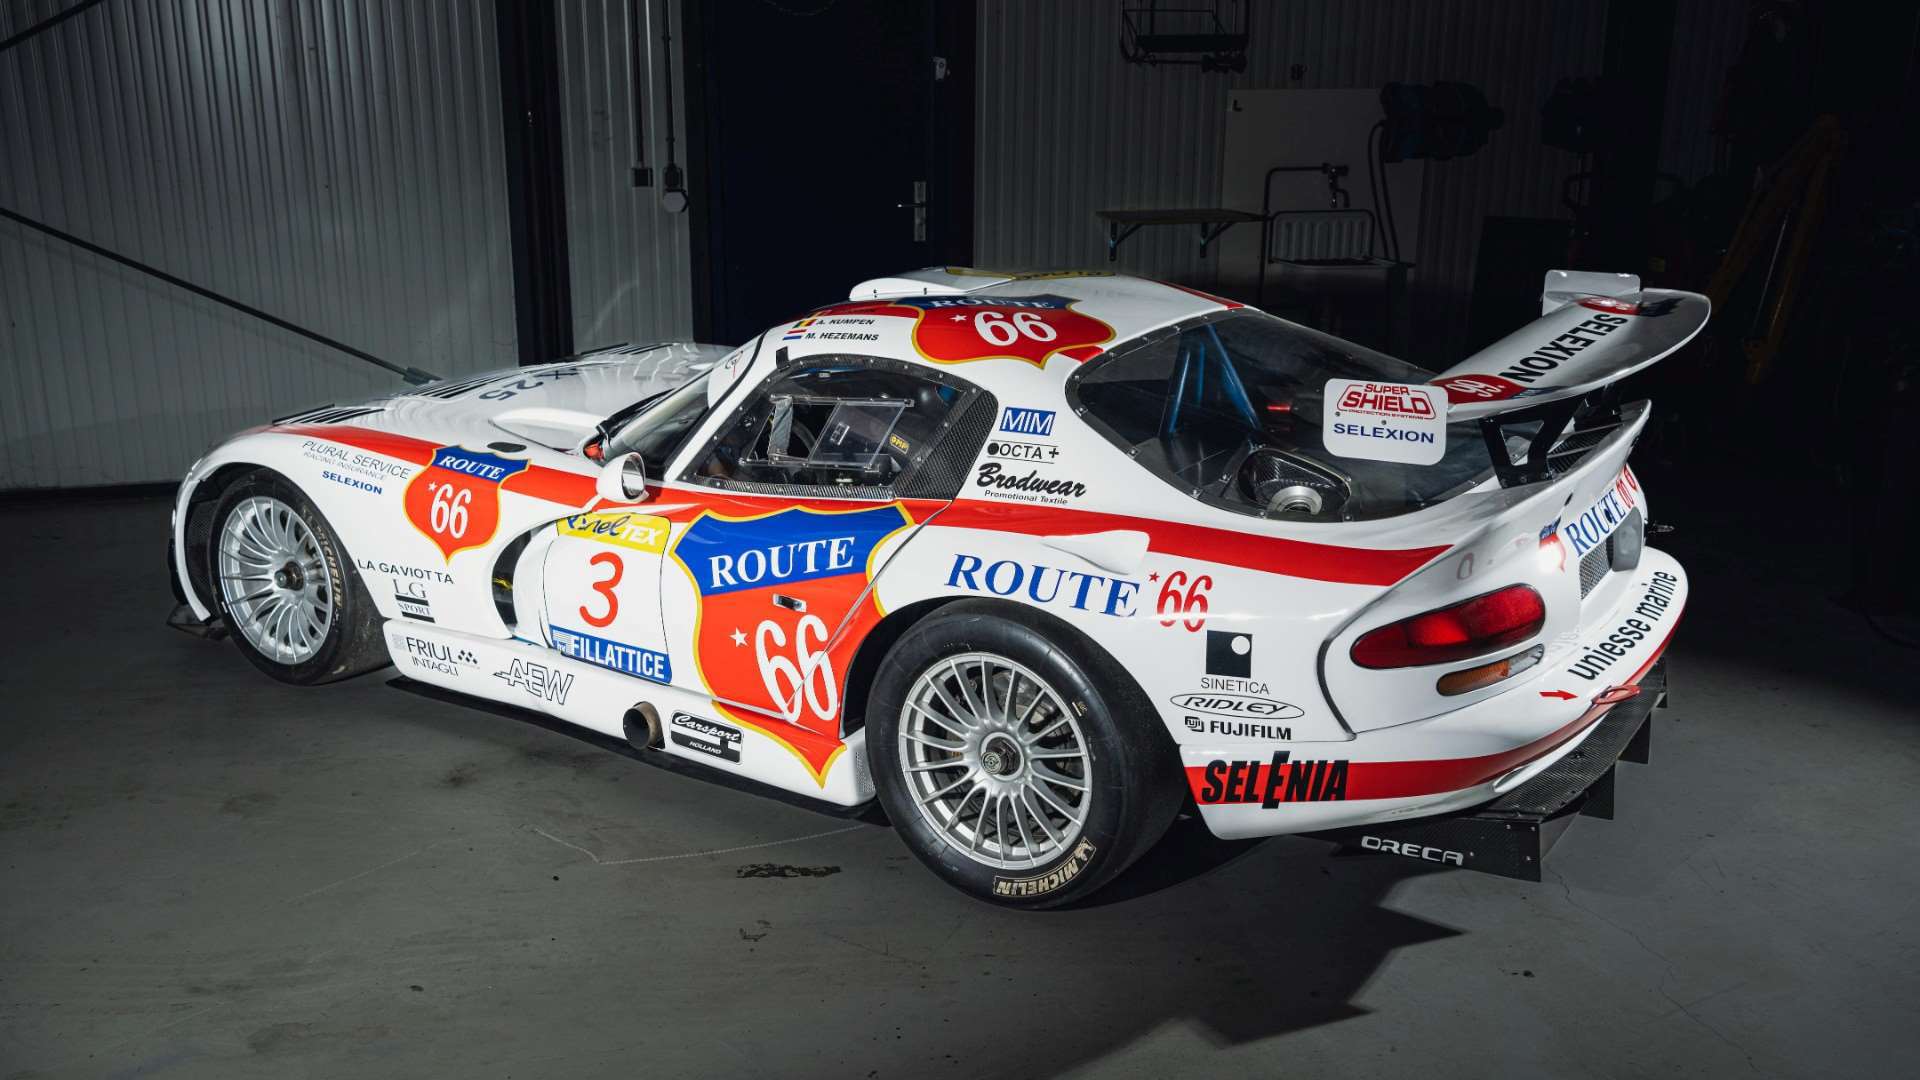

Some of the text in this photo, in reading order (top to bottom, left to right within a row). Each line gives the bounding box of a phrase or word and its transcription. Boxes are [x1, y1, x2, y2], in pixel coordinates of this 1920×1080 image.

[931, 299, 1056, 309] ROUTE
[819, 332, 879, 341] HEZEMANS
[974, 311, 1057, 346] 66
[1498, 313, 1629, 383] SELEXION
[1364, 384, 1410, 395] SUPER
[1342, 391, 1431, 415] SHIELD
[1001, 409, 1054, 435] MIM
[1333, 423, 1434, 444] SELEXION
[302, 440, 411, 480] PLURAL SERVICE
[1000, 443, 1042, 460] OCTA
[439, 454, 505, 480] ROUTE
[976, 462, 1087, 498] Brodwear
[322, 470, 383, 495] SELEXION
[984, 490, 1068, 505] Promotional Textile
[430, 483, 472, 540] 66
[1564, 487, 1627, 557] ROUTE
[357, 559, 454, 585] LA GAVIOTTA
[708, 536, 855, 588] ROUTE
[393, 578, 427, 599] LG
[579, 551, 624, 628] 3
[943, 552, 1214, 633] ROUTE 66
[398, 602, 431, 616] SPORT
[1567, 570, 1679, 682] uniesse marine
[571, 636, 665, 679] FILLATTICE
[754, 614, 839, 723] 66
[494, 658, 574, 705] AEW
[1201, 677, 1270, 695] SINETICA
[1184, 697, 1288, 715] RIDLEY
[674, 715, 740, 741] Carsport
[1210, 721, 1292, 740] FUJIFILM
[689, 741, 722, 755] HOLLAND
[1202, 751, 1350, 809] SELENIA
[1361, 835, 1464, 866] ORECA
[995, 858, 1079, 896] MICHELIN
